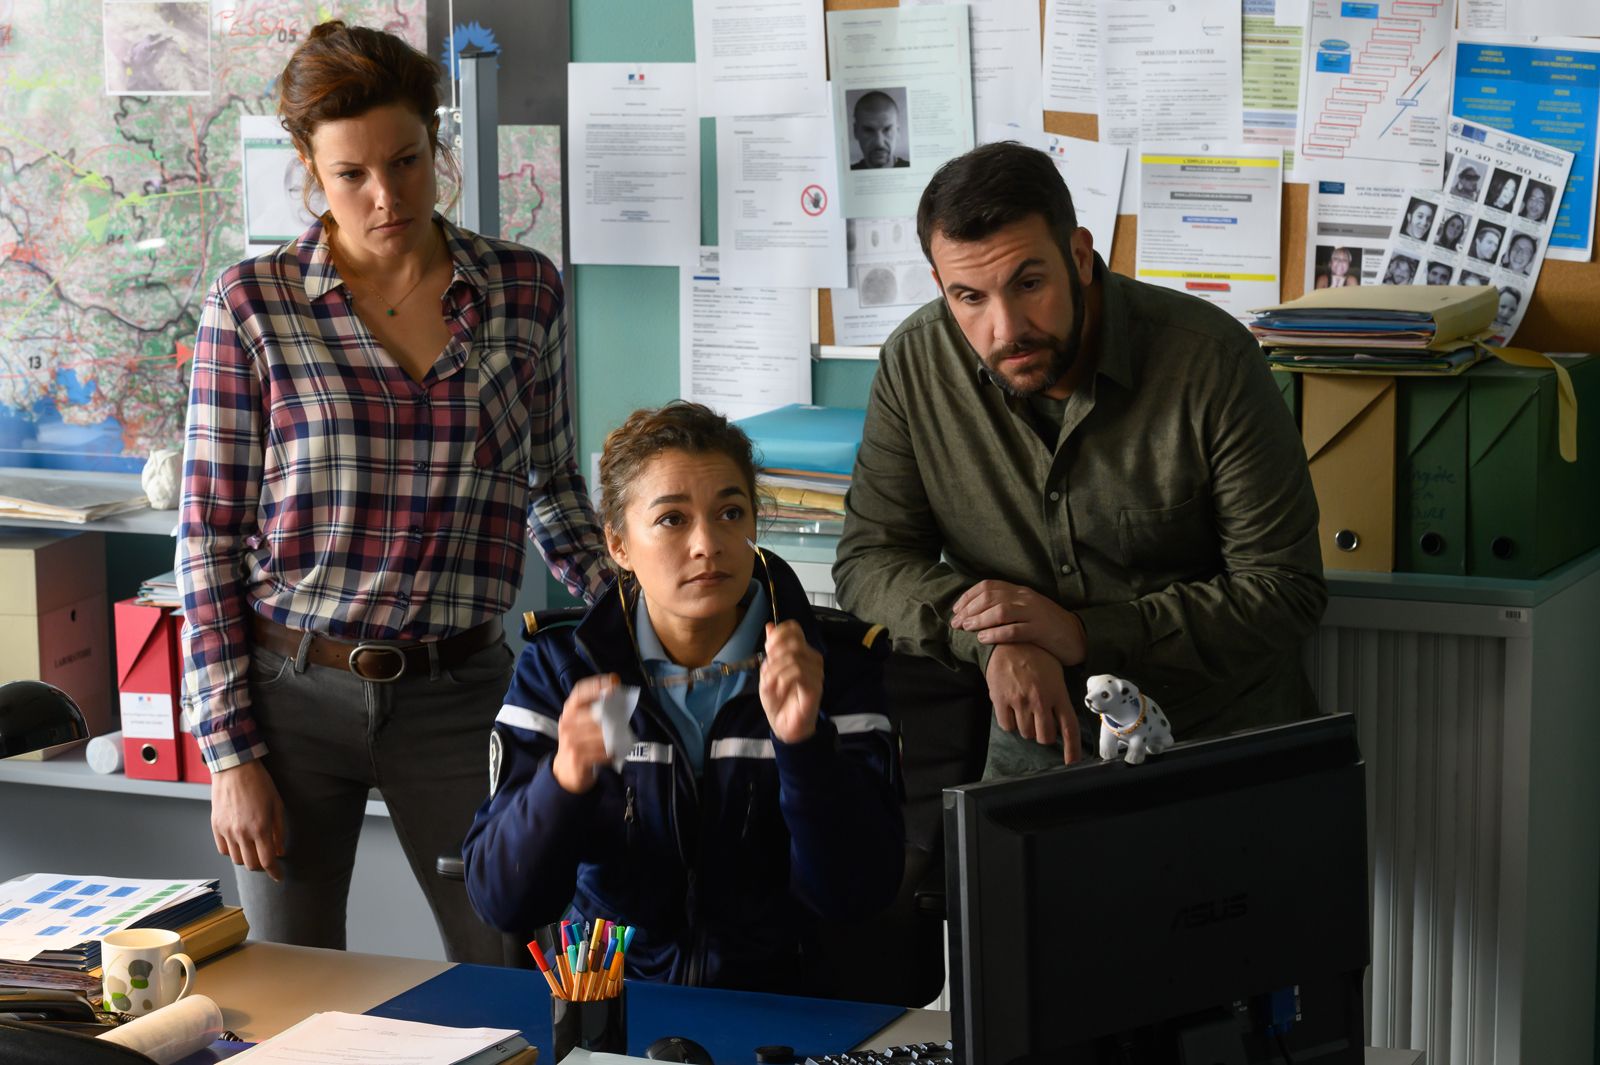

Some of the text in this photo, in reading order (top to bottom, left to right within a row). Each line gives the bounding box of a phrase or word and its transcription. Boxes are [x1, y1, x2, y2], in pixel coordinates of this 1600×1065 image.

[1454, 146, 1469, 155] 01
[28, 355, 42, 370] 13
[1170, 892, 1249, 934] ASUS
